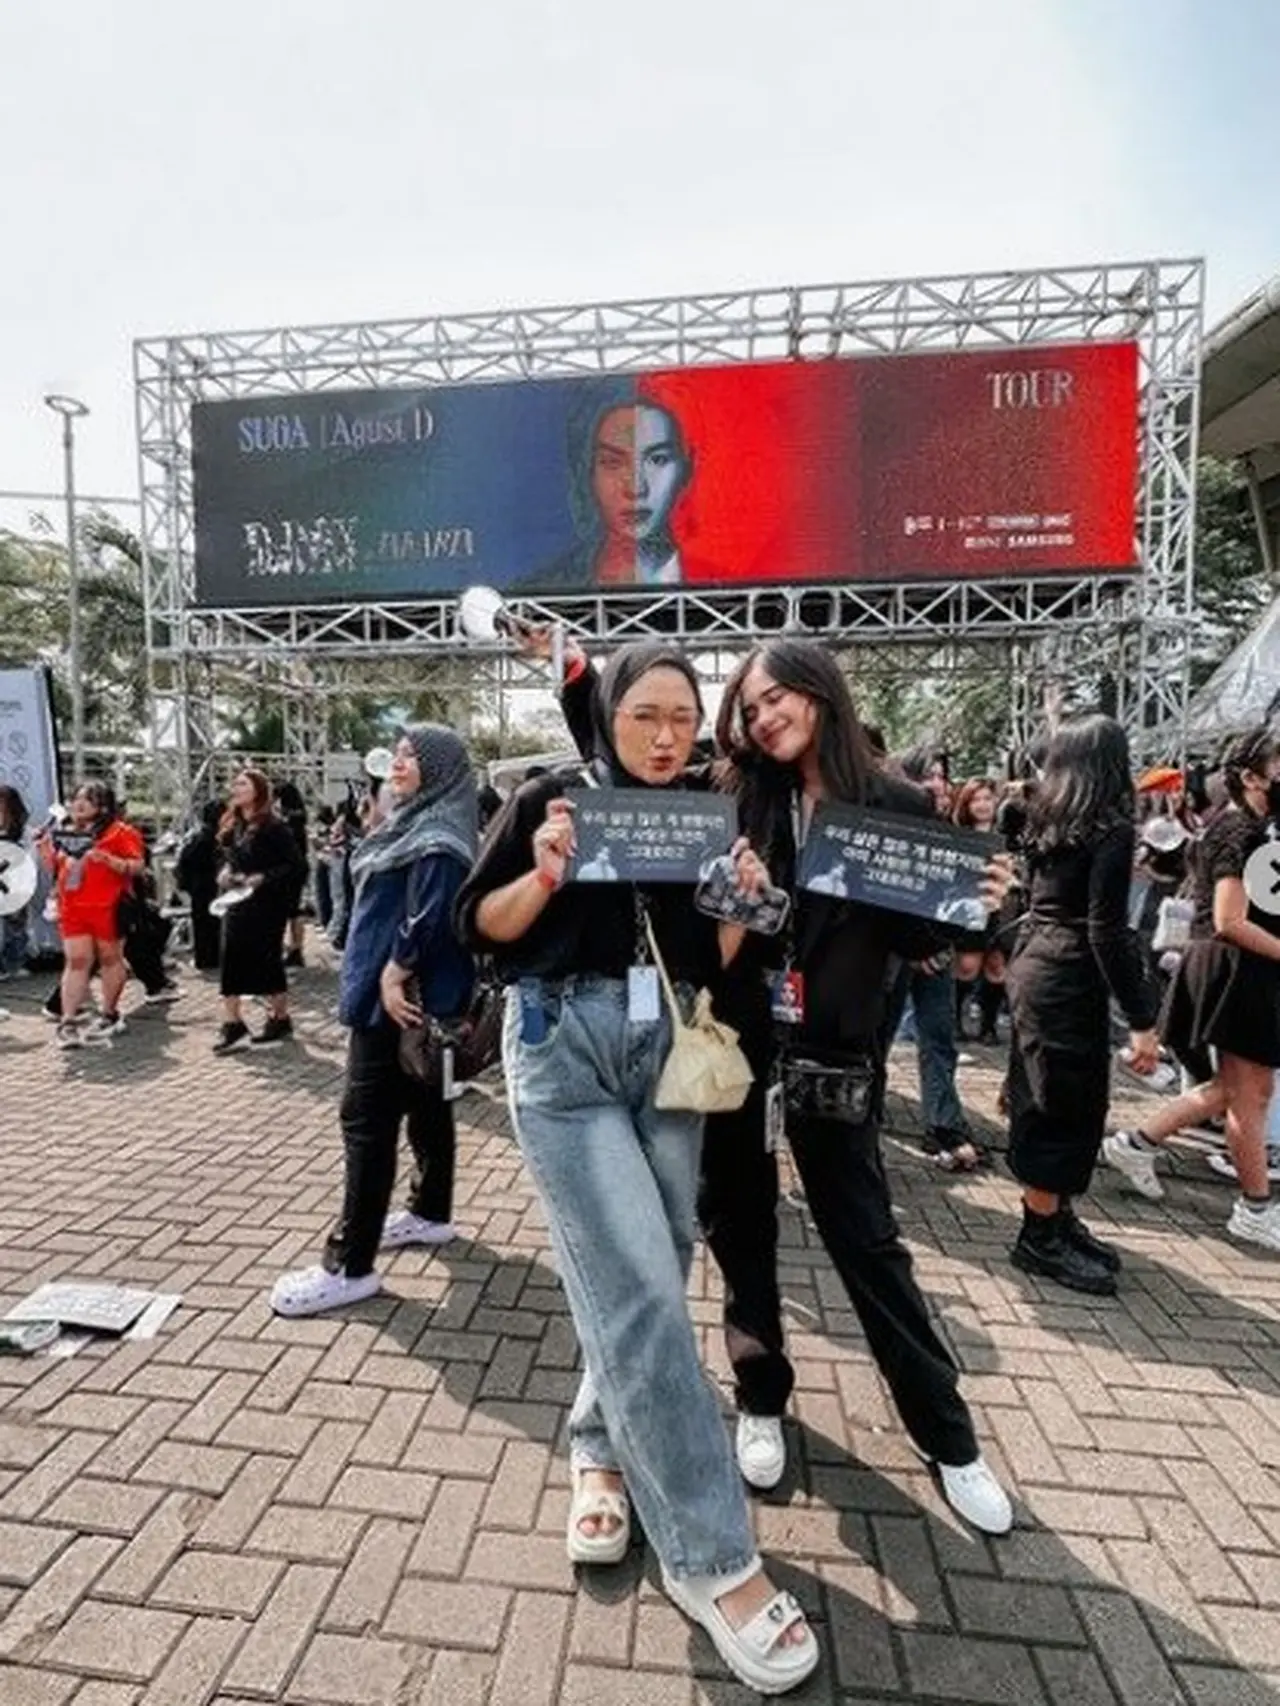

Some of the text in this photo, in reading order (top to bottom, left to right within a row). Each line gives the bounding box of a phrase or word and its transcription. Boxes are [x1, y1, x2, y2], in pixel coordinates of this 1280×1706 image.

[986, 369, 1075, 409] TOUR
[238, 414, 310, 452] SUGA
[329, 411, 407, 451] Agust
[414, 406, 434, 441] D
